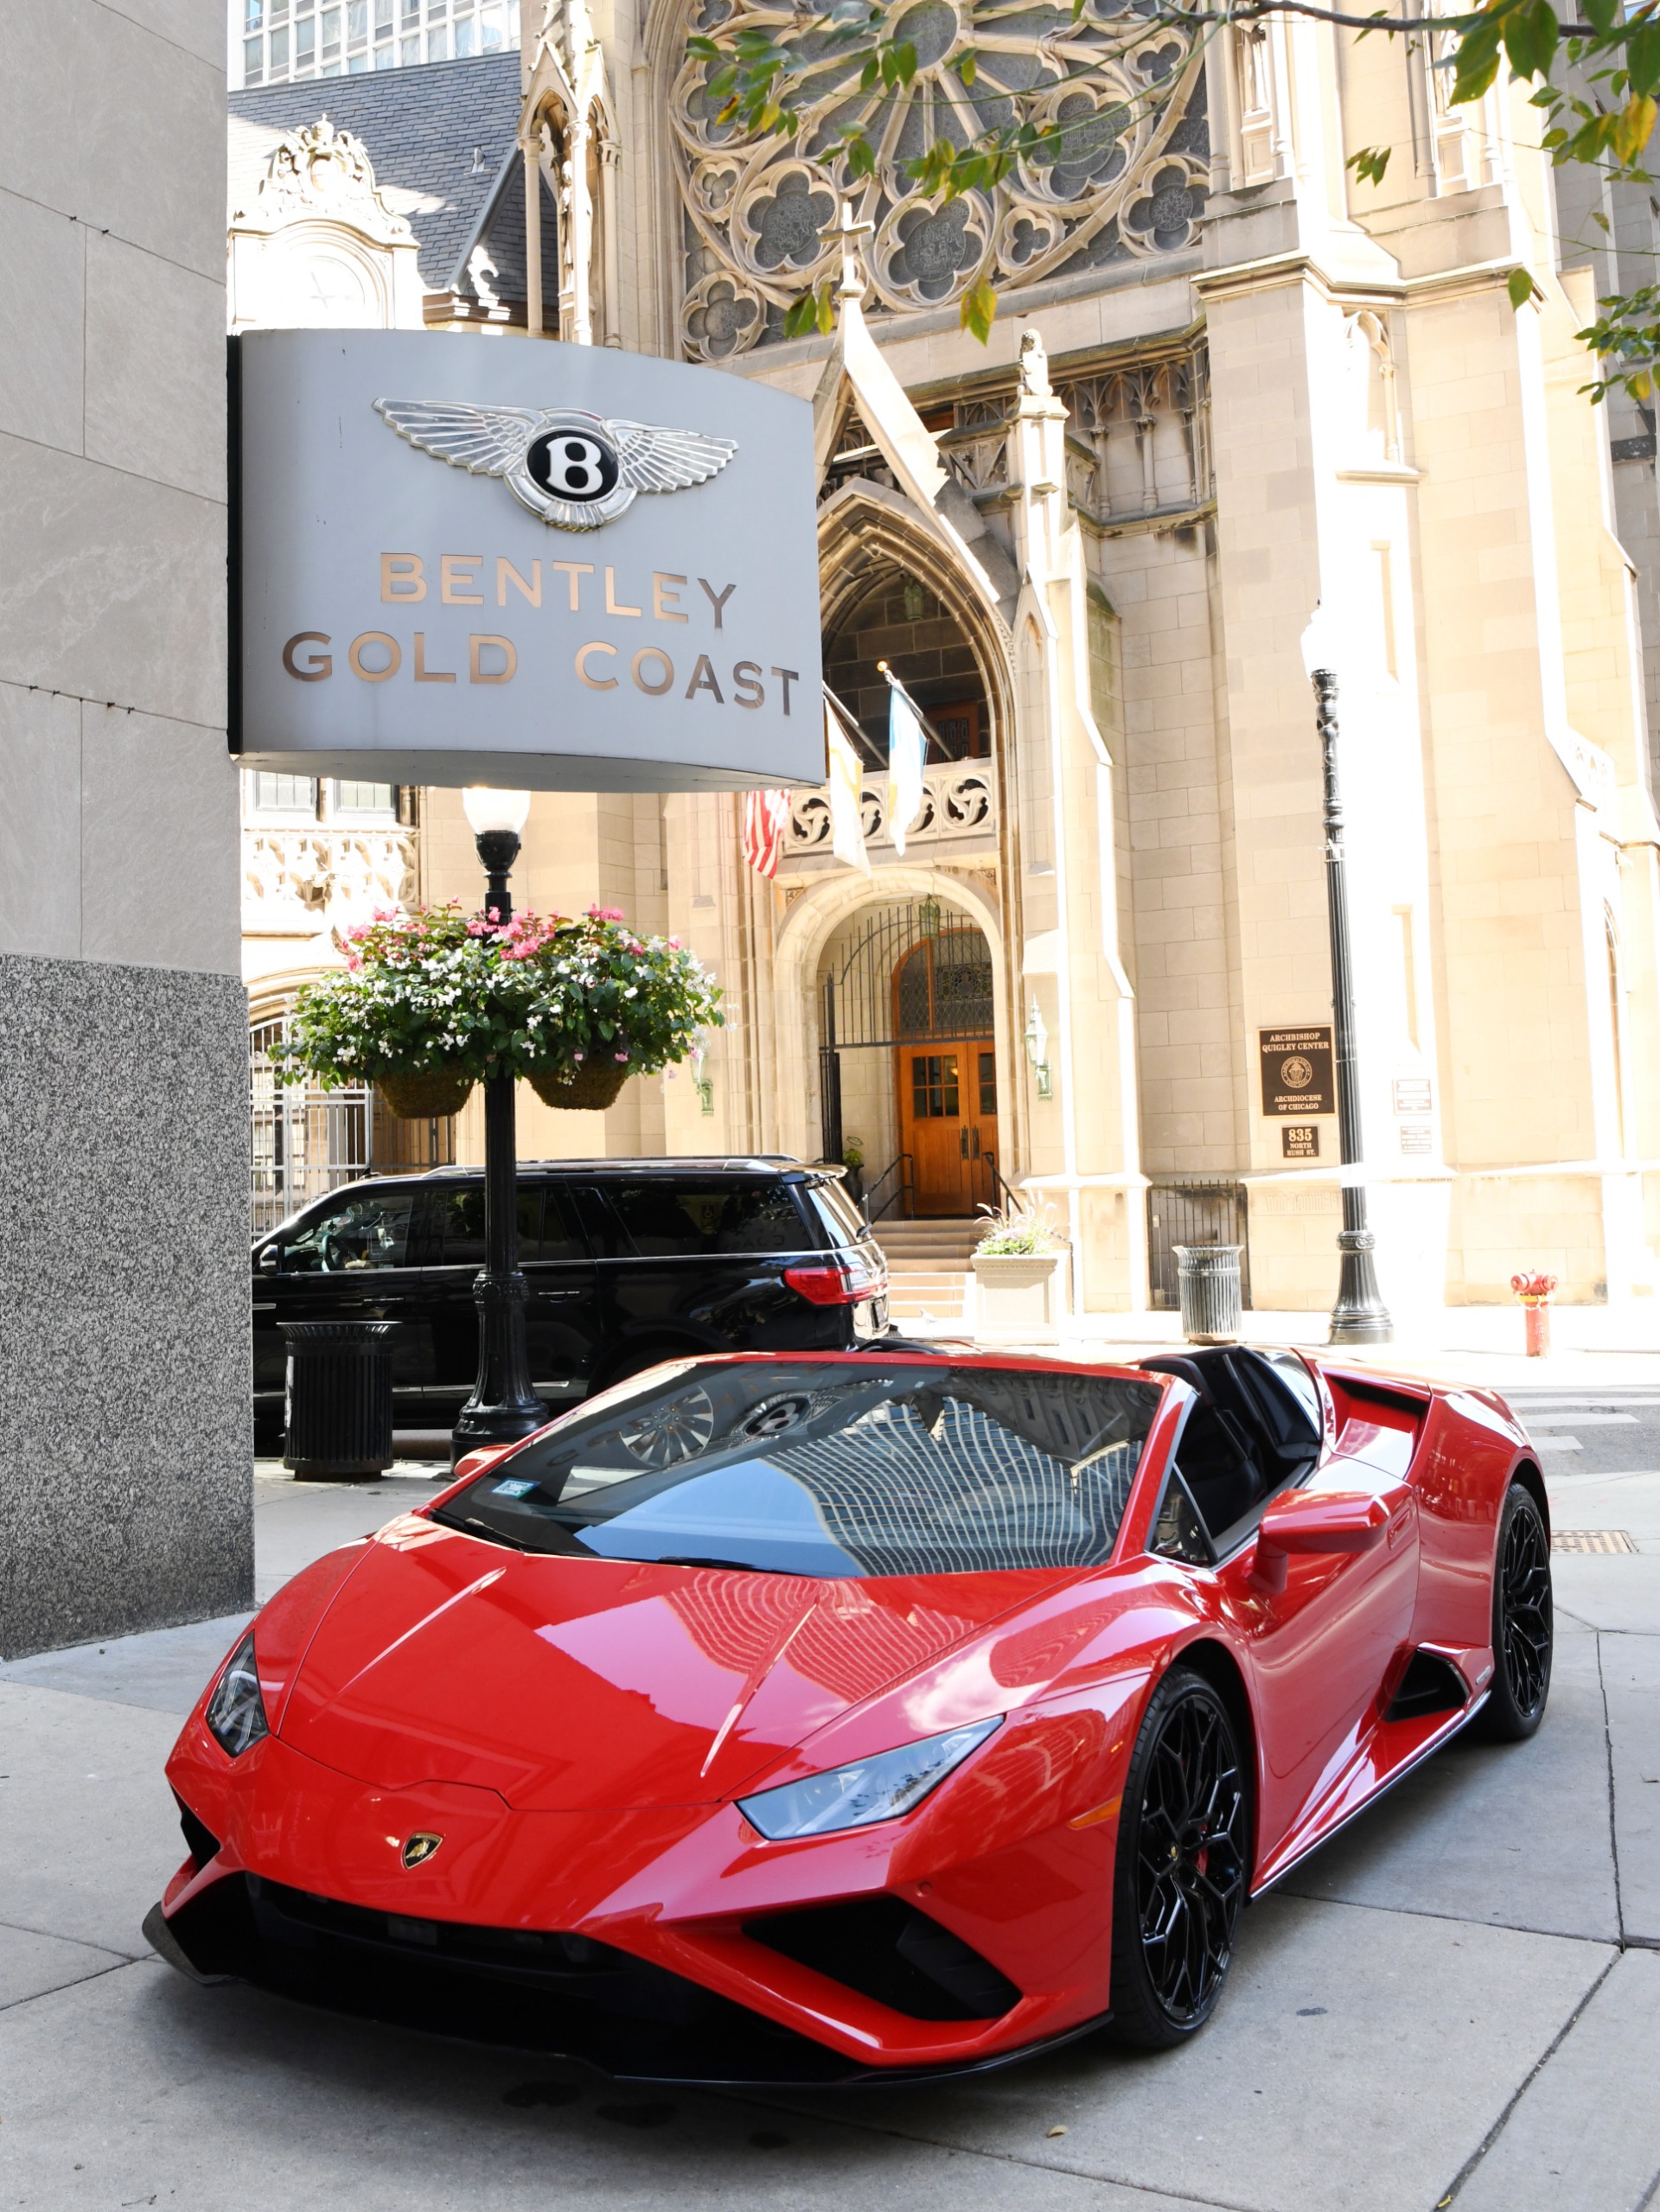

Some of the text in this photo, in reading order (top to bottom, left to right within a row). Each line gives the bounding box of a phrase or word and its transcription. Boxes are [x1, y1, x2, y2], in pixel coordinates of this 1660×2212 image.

[380, 552, 737, 629] BENTLEY
[282, 631, 800, 716] GOLD COAST
[1269, 1032, 1320, 1042] ARCHBISHOP
[1262, 1042, 1329, 1053] QUIGLEY CENTER
[1288, 1128, 1312, 1142] 835
